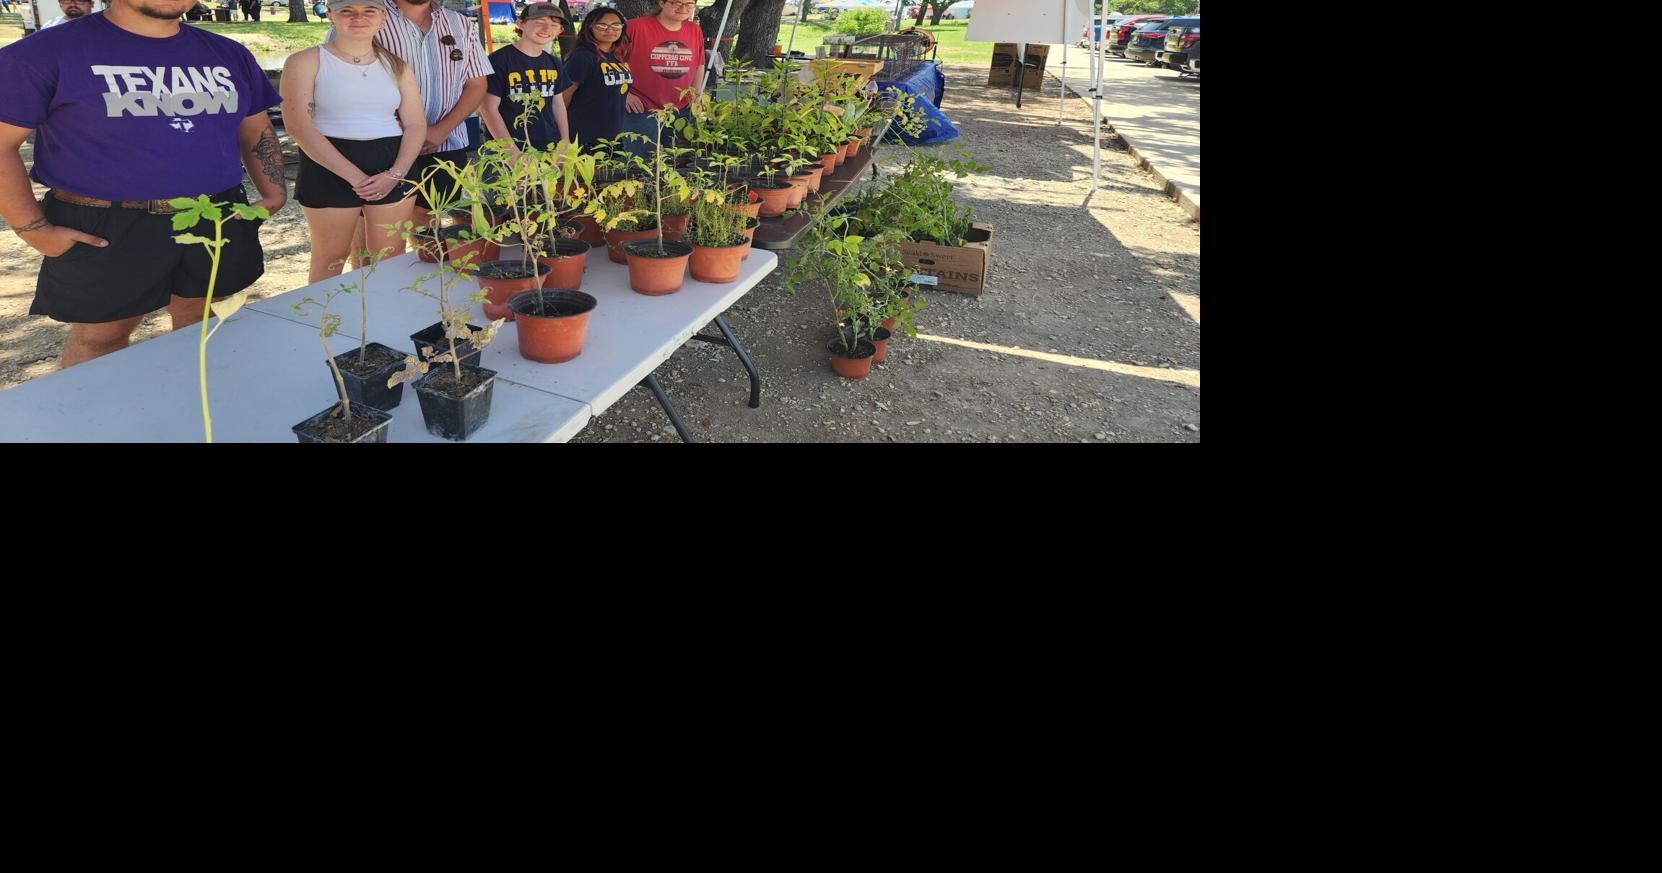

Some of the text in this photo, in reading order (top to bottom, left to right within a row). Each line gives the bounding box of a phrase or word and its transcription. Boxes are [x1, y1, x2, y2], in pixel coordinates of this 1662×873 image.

[650, 53, 693, 62] COPPERAS COVE
[90, 64, 237, 98] TEXANS
[102, 90, 239, 118] KNOW
[921, 267, 979, 283] TAINS
